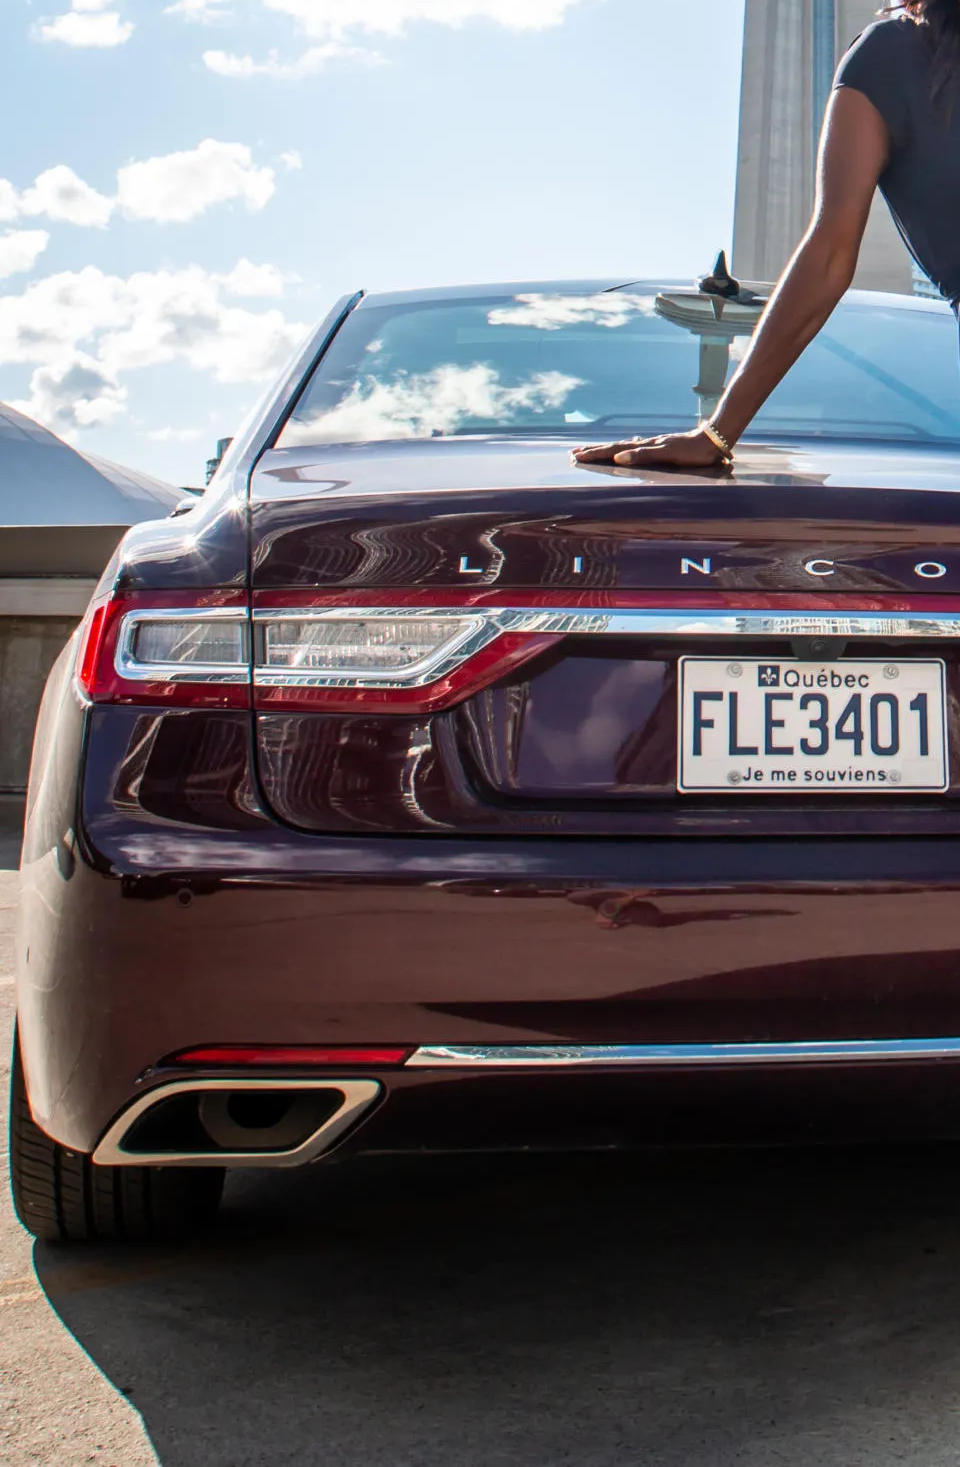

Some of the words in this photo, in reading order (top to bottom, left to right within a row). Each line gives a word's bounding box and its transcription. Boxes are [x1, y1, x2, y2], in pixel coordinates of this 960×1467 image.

[783, 669, 870, 688] Québec
[692, 691, 929, 756] FLE3401
[742, 767, 764, 782] Je
[771, 768, 797, 782] me
[803, 766, 887, 782] souviens
